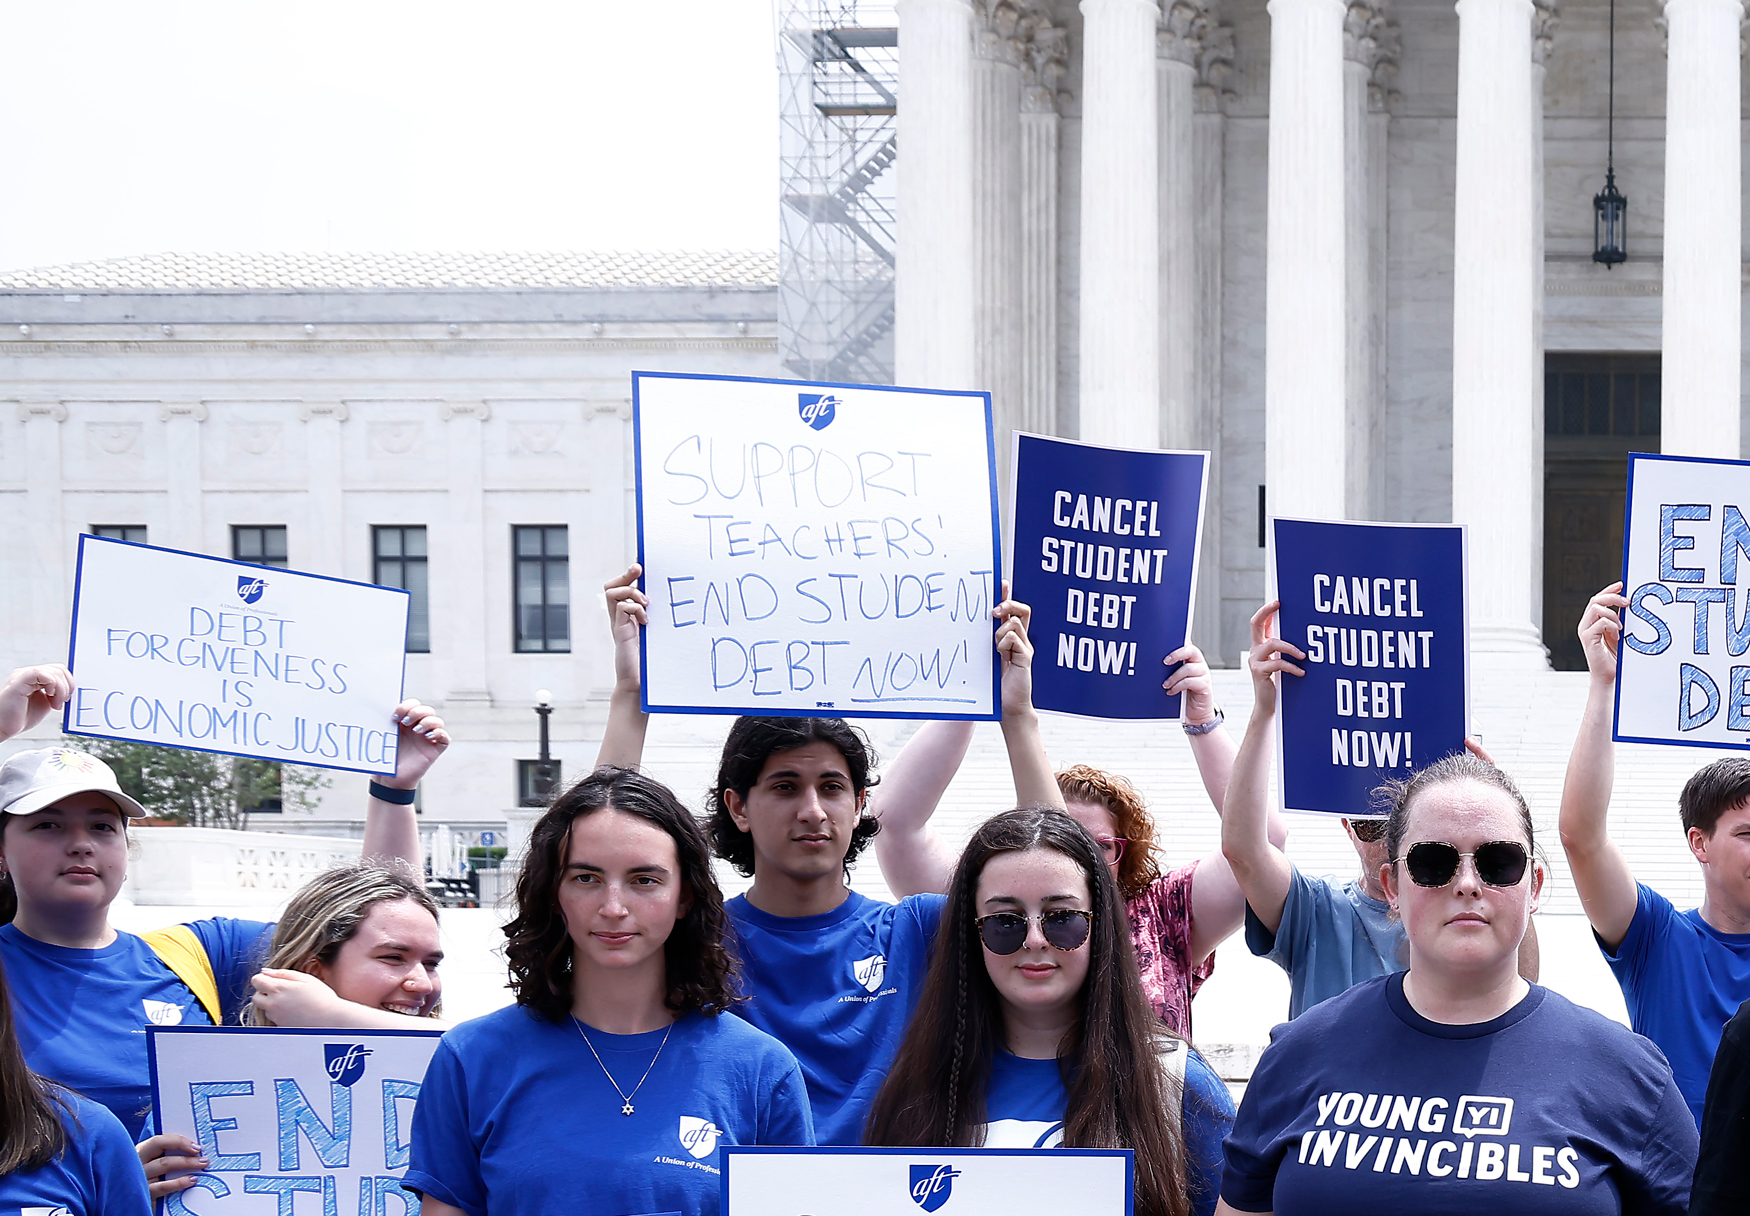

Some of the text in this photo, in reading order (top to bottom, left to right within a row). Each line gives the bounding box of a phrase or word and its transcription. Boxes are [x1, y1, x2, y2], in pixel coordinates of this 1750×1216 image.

[800, 394, 843, 427] aft
[662, 434, 932, 509] SUPPORT
[1053, 489, 1161, 538] CANCEL
[693, 514, 948, 560] TEACHERS!
[1040, 536, 1168, 585] STUDENT
[237, 576, 270, 602] aft
[667, 569, 994, 628] END STUDENT
[1066, 589, 1136, 630] DEBT
[1313, 573, 1424, 617] CANCEL
[189, 606, 295, 649] DEBT
[1306, 625, 1434, 669] STUDENT
[106, 627, 348, 696] FORGIVENESS
[711, 637, 969, 699] DEBT NOW!
[1057, 633, 1136, 676] NOW!
[221, 678, 253, 707] IS
[1336, 679, 1406, 719] DEBT
[75, 686, 398, 766] ECONOMIC JUSTICE
[1331, 728, 1413, 769] NOW!
[859, 954, 888, 987] aft
[328, 1043, 375, 1083] aft
[188, 1077, 423, 1172] END
[1315, 1091, 1449, 1134] YOUNG
[683, 1120, 724, 1151] aft
[661, 1156, 686, 1166] Union
[686, 1161, 695, 1169] of
[1297, 1130, 1580, 1189] INVINCIBLES
[912, 1162, 962, 1207] aft
